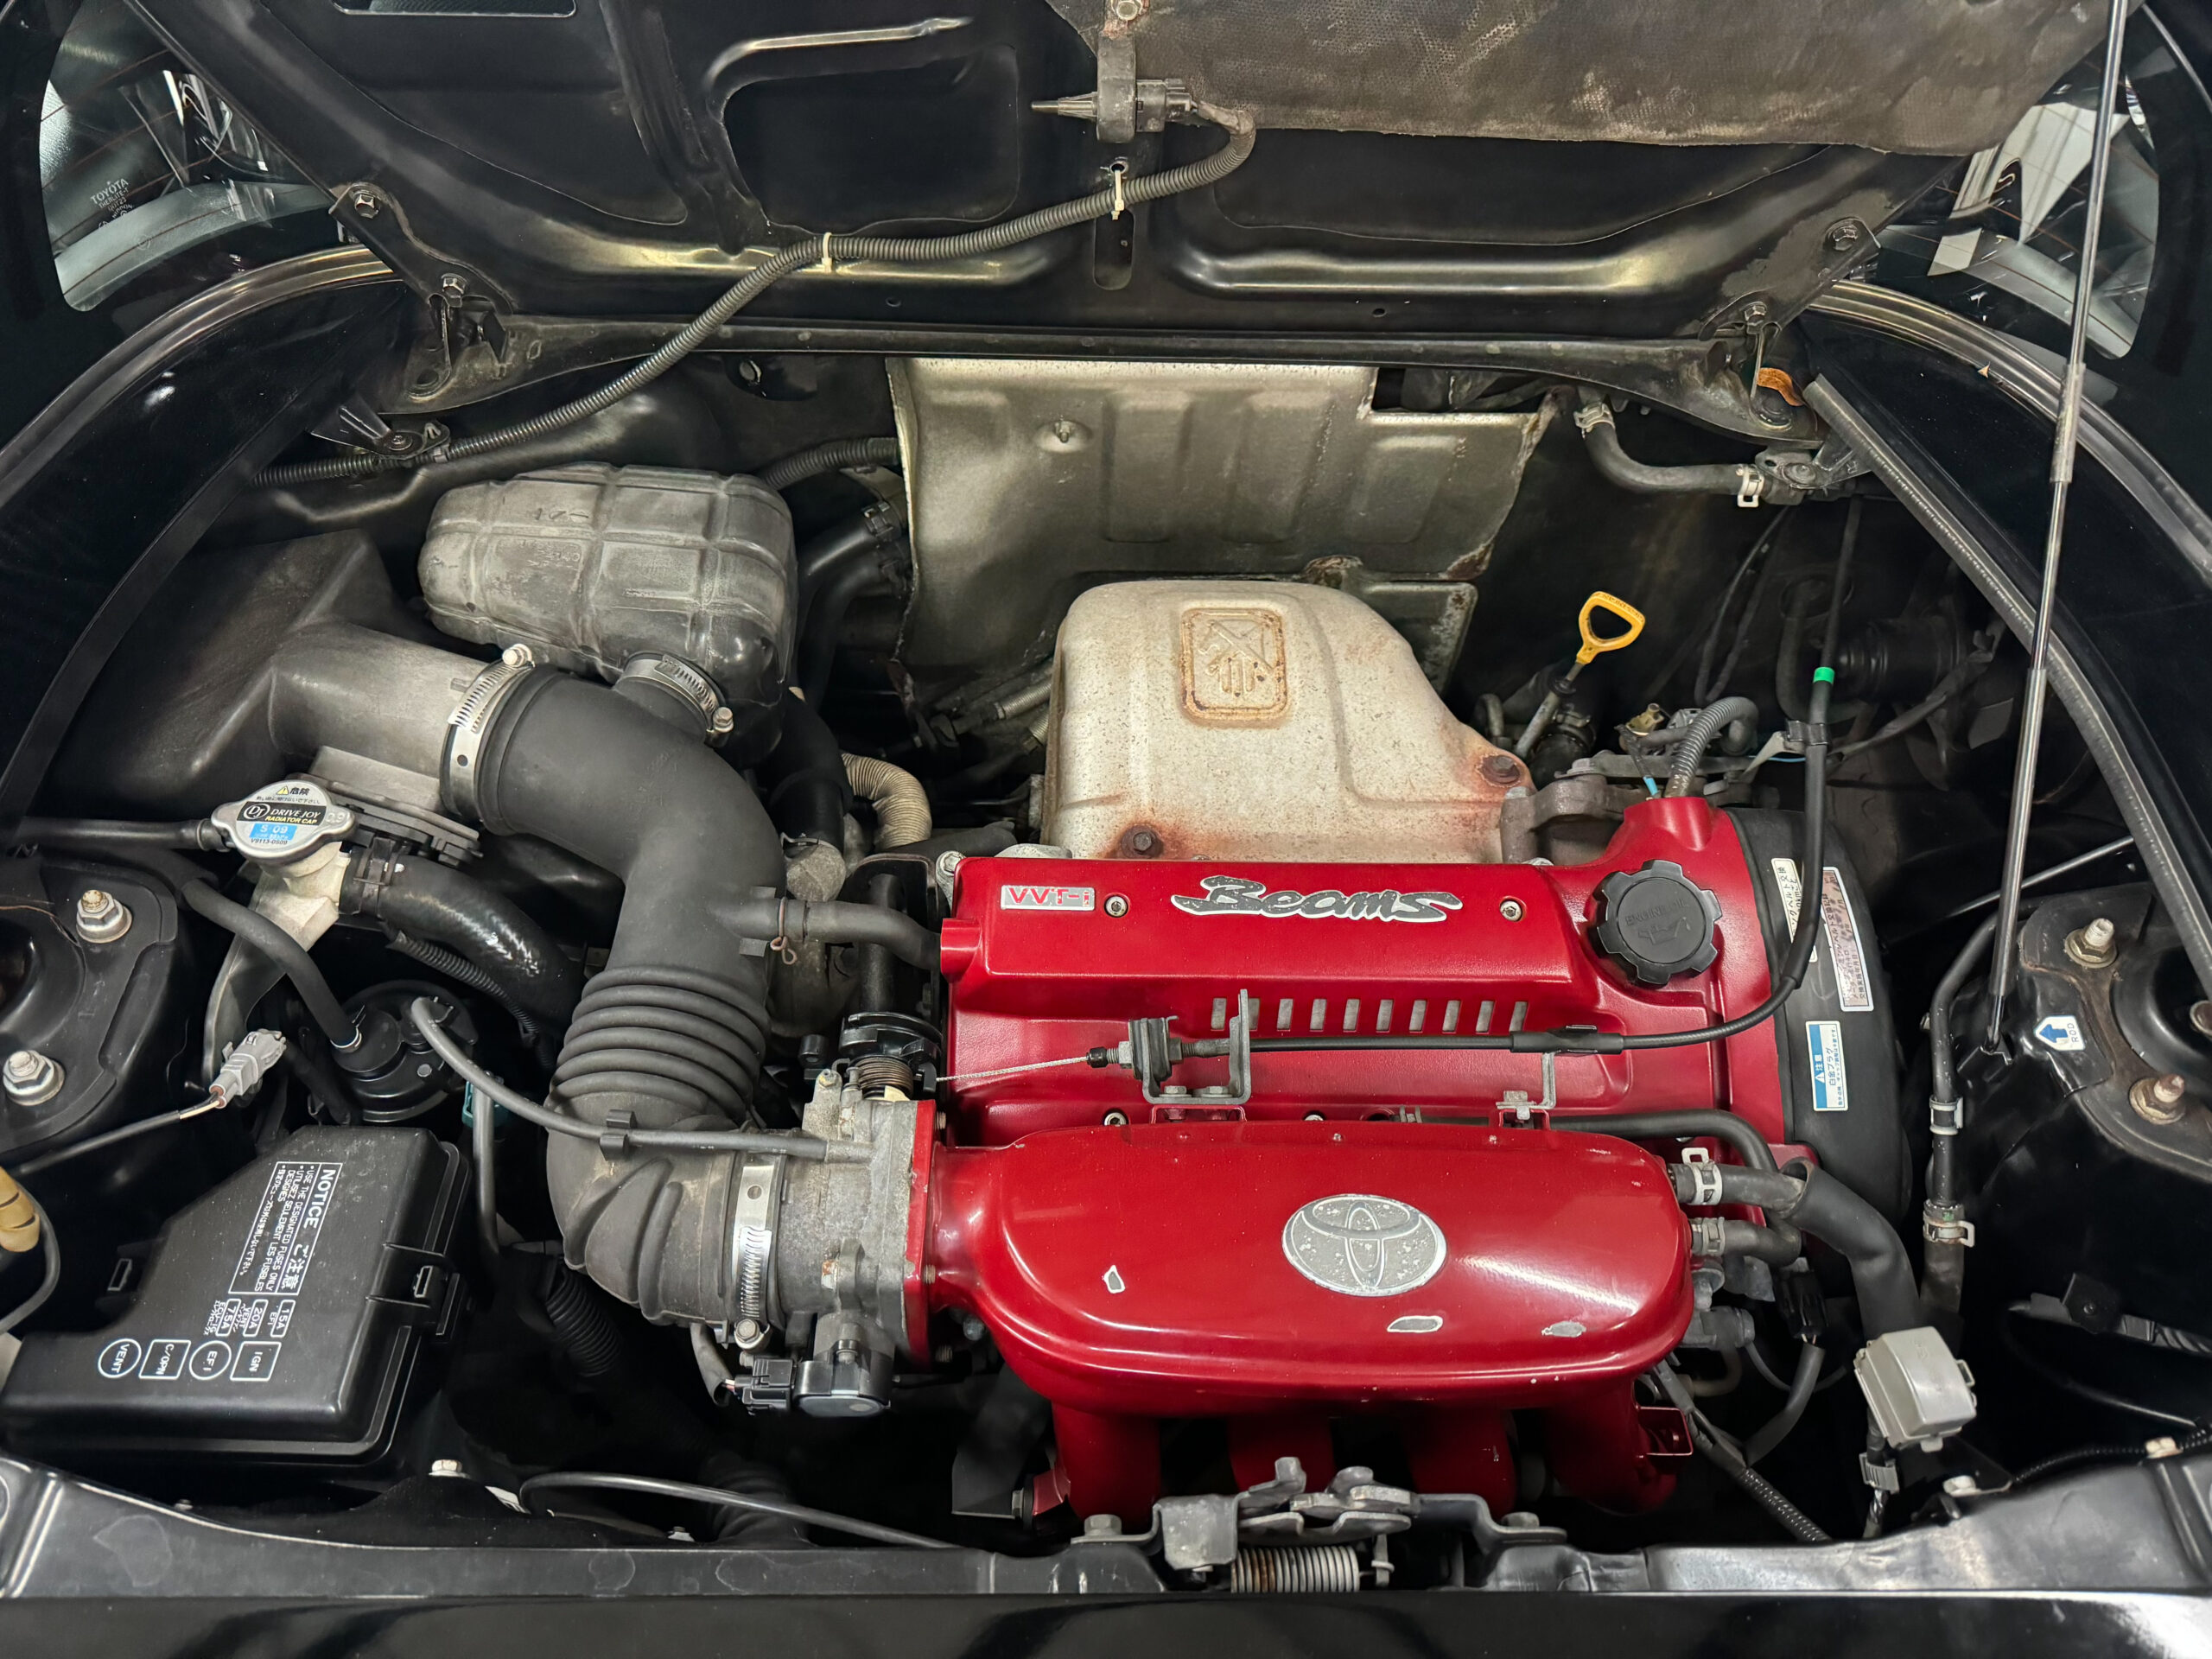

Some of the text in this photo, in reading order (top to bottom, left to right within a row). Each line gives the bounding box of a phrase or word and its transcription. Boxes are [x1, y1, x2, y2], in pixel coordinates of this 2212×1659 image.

[90, 178, 129, 204] TOYOTA
[289, 787, 310, 796] 危険
[270, 808, 302, 817] DRIVE
[260, 824, 289, 834] S 09
[1171, 875, 1463, 923] Beams
[2067, 1022, 2080, 1043] ROD
[1815, 1054, 1824, 1071] 注意
[1826, 1047, 1836, 1086] 白金プラグ
[303, 1169, 336, 1229] NOTICE
[254, 1170, 304, 1292] UTILISEZ SEULEMENT LES FUSIBLES
[265, 1170, 315, 1291] USE THE DESIGNATED FUSES ONLY
[282, 1244, 309, 1290] ご注意
[220, 1306, 237, 1330] 7.5A
[238, 1306, 251, 1329] VENT
[249, 1307, 264, 1330] 20A
[267, 1312, 277, 1325] EFI
[276, 1308, 290, 1330] 15A
[111, 1344, 130, 1373] VENT
[156, 1344, 175, 1375] C/OPN
[203, 1351, 218, 1371] EFI
[249, 1351, 263, 1372] IGN
